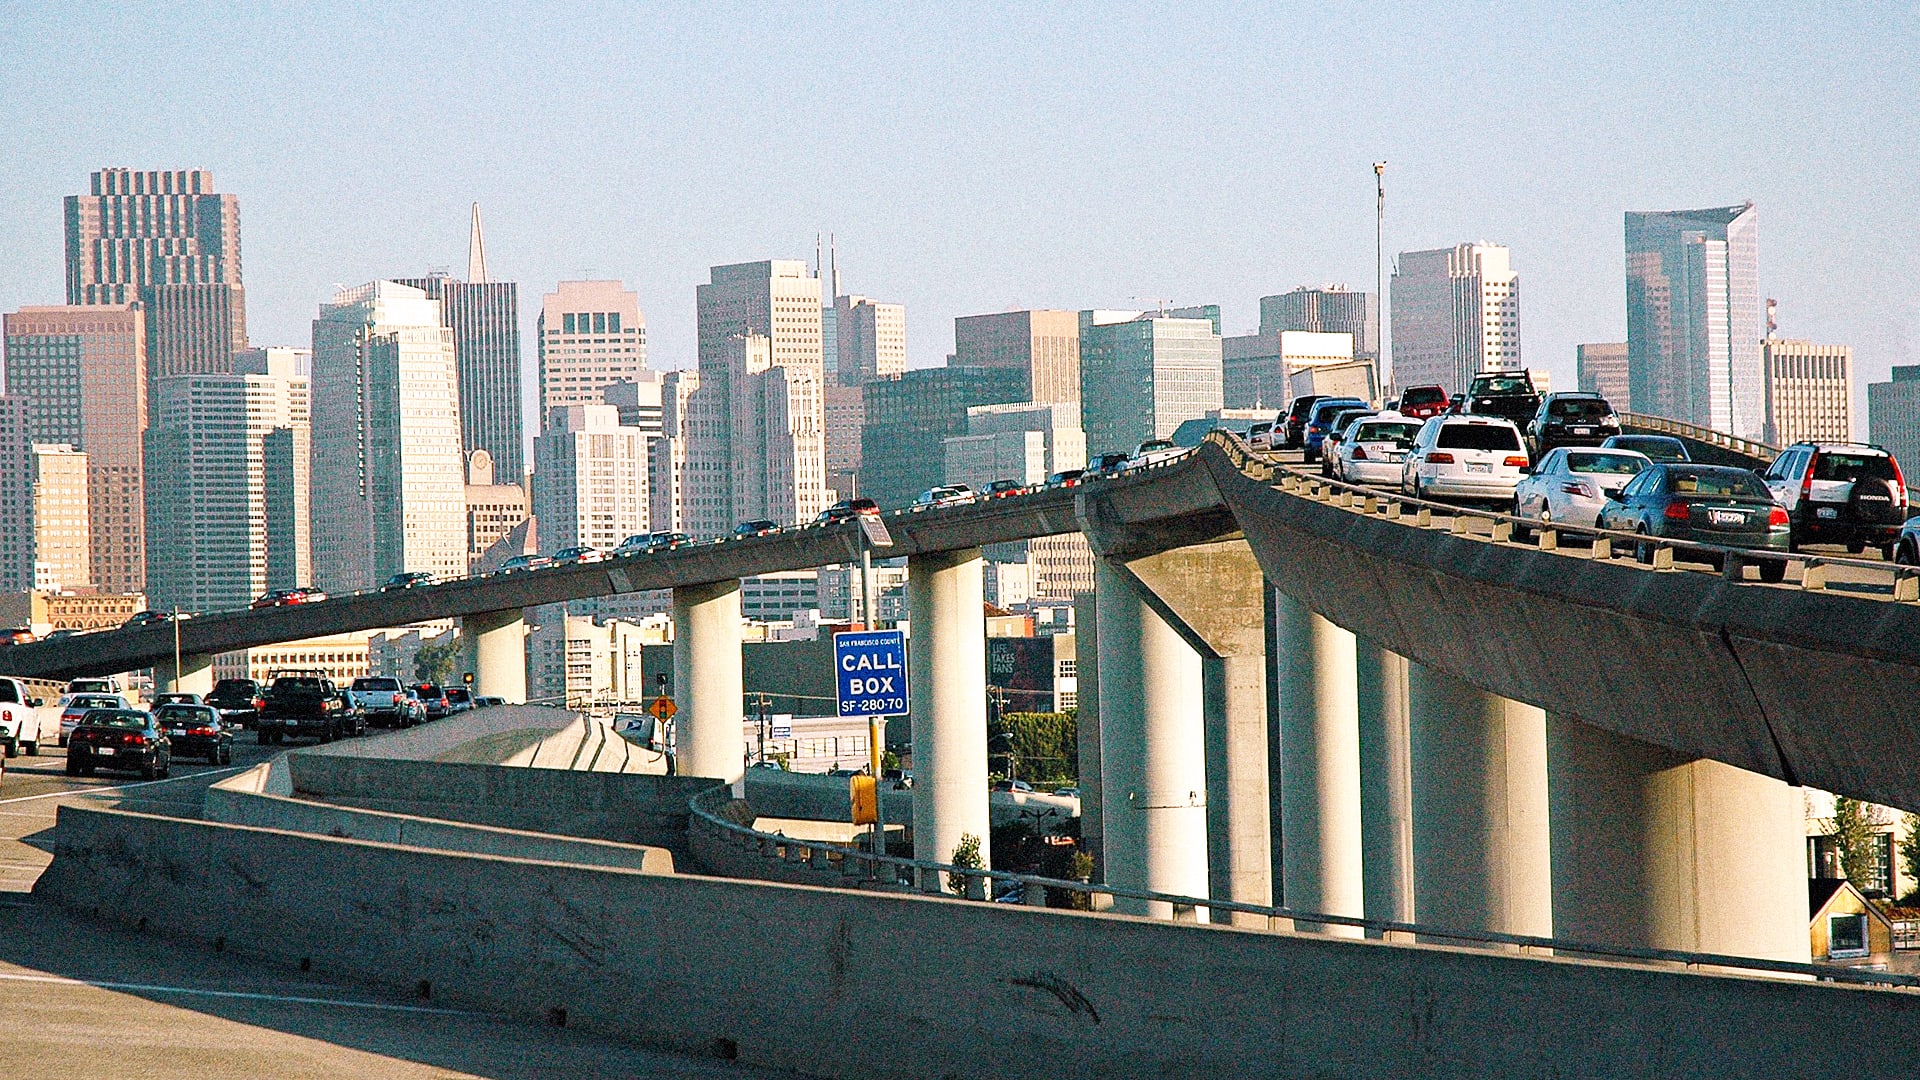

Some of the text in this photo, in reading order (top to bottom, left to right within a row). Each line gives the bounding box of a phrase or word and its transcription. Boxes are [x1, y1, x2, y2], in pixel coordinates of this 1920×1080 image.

[851, 639, 879, 647] FRANCISCO
[993, 643, 1007, 653] LIFE
[842, 653, 900, 671] CALL
[992, 654, 1015, 663] TAKES
[992, 663, 1013, 673] FANS
[850, 677, 894, 694] BOX
[841, 698, 903, 712] SF-280-70
